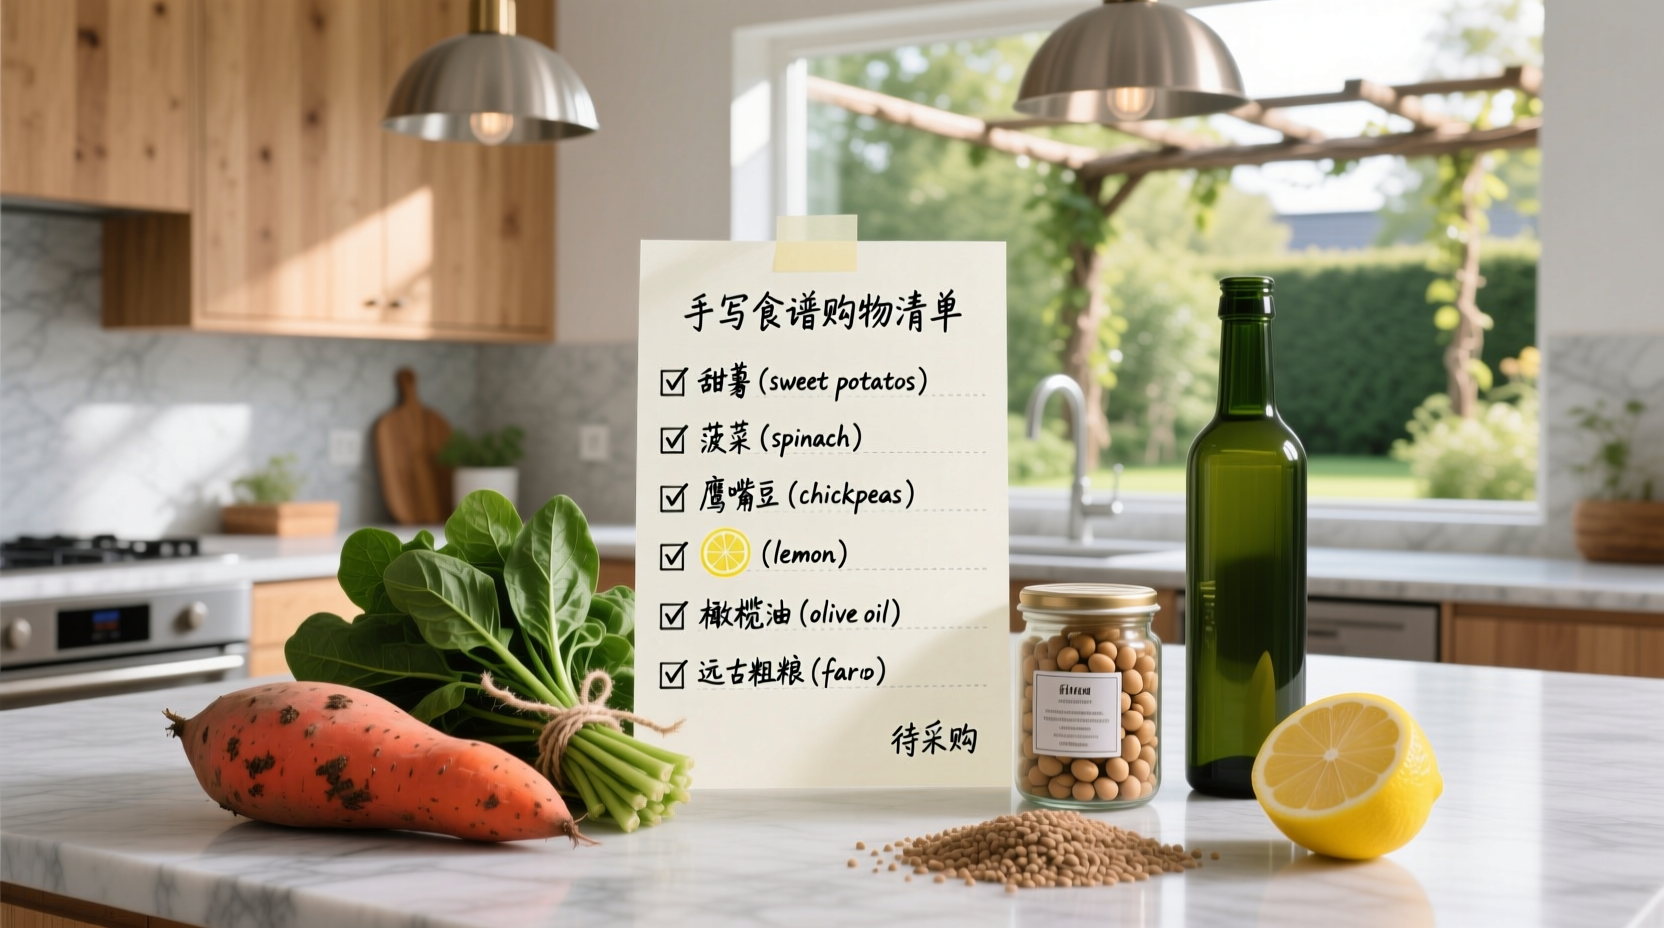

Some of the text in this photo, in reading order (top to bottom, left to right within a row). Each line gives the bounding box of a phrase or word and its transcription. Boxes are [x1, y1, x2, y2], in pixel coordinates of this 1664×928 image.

[683, 288, 963, 334] 手写食谱购物清单
[758, 366, 829, 396] (sweet
[834, 366, 928, 402] potatos)
[700, 419, 862, 458] 菠菜 (spinach)
[699, 475, 915, 515] 鹰嘴豆 (chickpeas)
[762, 538, 848, 569] (lemon)
[698, 595, 901, 631] 橄榄油 (olive oil)
[697, 654, 805, 688] 远古粗粮
[890, 719, 978, 758] 待采购
